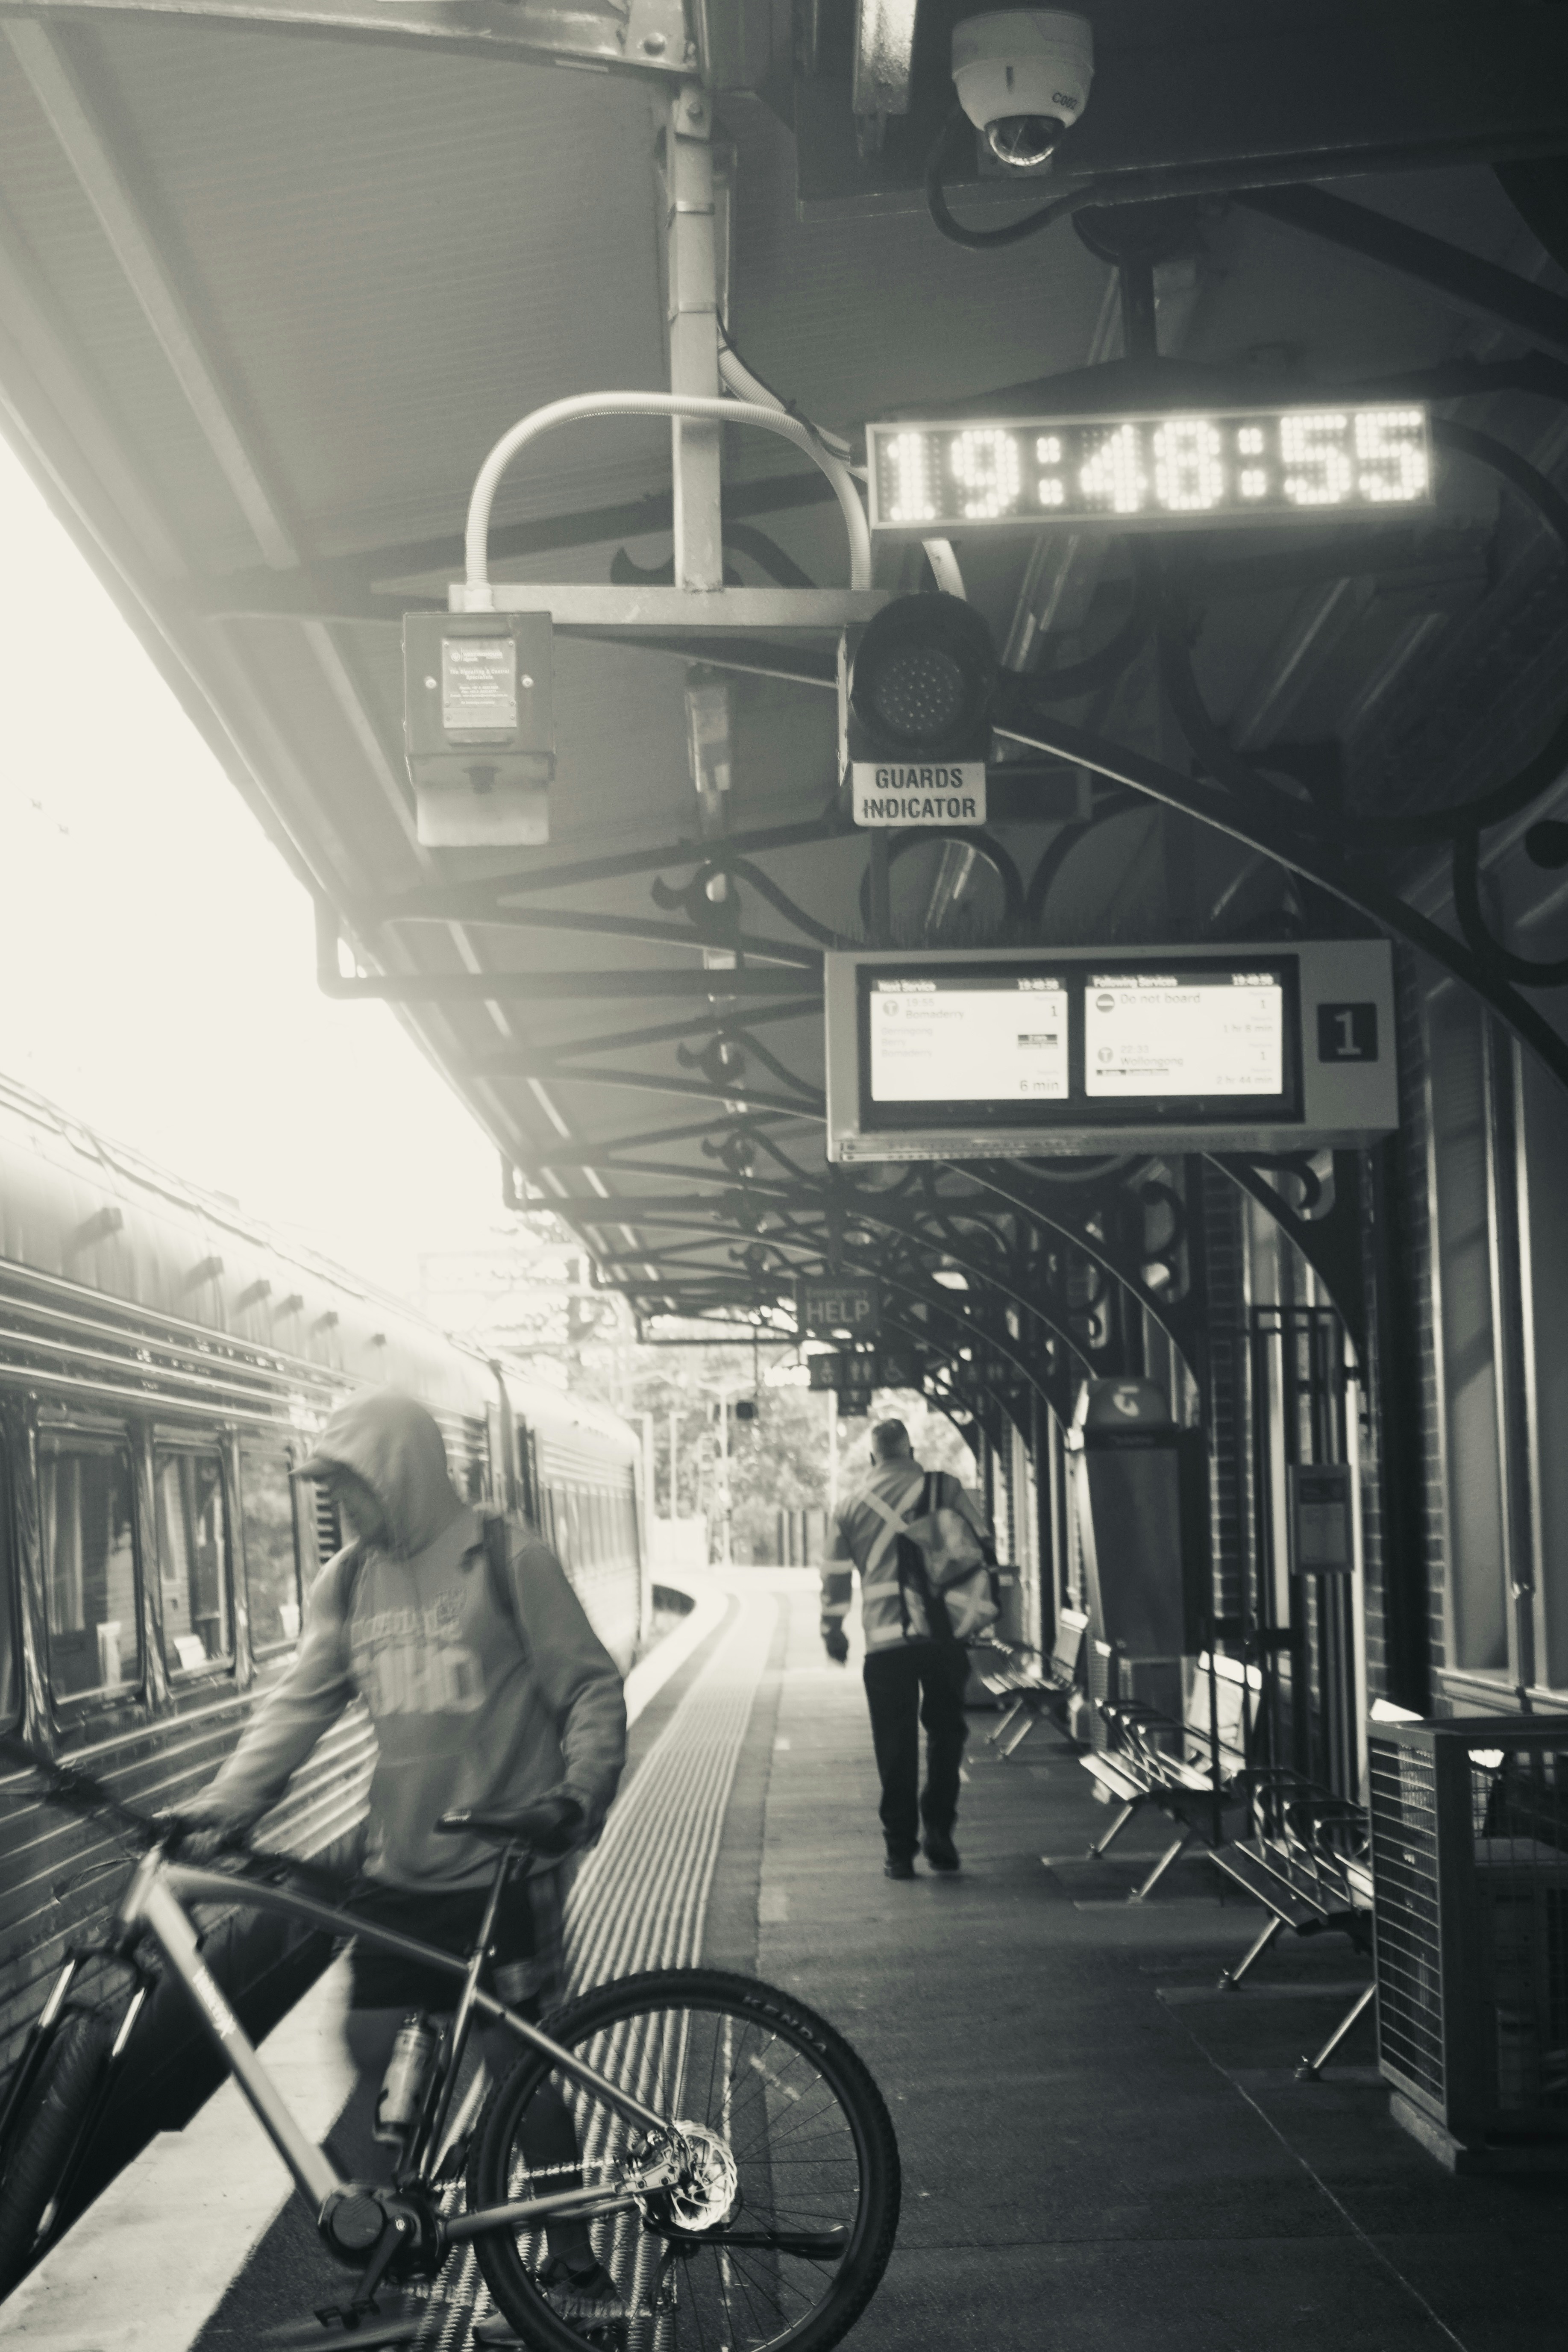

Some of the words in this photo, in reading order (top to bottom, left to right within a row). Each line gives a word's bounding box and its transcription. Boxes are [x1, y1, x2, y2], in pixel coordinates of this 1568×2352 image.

[887, 410, 1426, 521] 19:48:55
[875, 768, 963, 789] GUARDS
[863, 798, 977, 819] INDICATOR
[878, 981, 901, 992] Next
[901, 981, 936, 992] Service
[1093, 976, 1137, 989] Following
[906, 998, 935, 1007] 19:55
[1120, 993, 1136, 1004] Do
[1140, 994, 1161, 1004] not
[1165, 992, 1201, 1004] board
[1260, 999, 1266, 1009] 1
[905, 1009, 965, 1020] Bomaderry
[1051, 1005, 1058, 1017] 1
[881, 1027, 933, 1037] Gerringong
[1223, 1025, 1229, 1034] 1
[1231, 1024, 1242, 1033] hr
[1254, 1025, 1274, 1033] min
[1335, 1010, 1362, 1055] 1
[881, 1038, 906, 1047] Berry
[881, 1048, 933, 1059] Bomaderry
[1120, 1045, 1149, 1054] 22:33
[1260, 1051, 1267, 1060] 1
[1120, 1056, 1184, 1068] Wollongong
[1020, 1080, 1029, 1092] 6
[1033, 1078, 1059, 1092] min
[1216, 1075, 1223, 1085] 2
[1225, 1075, 1235, 1084] hr
[1239, 1075, 1252, 1084] 44
[1254, 1075, 1274, 1084] min
[806, 1299, 870, 1324] HELP
[743, 1995, 826, 2054] KENDA
